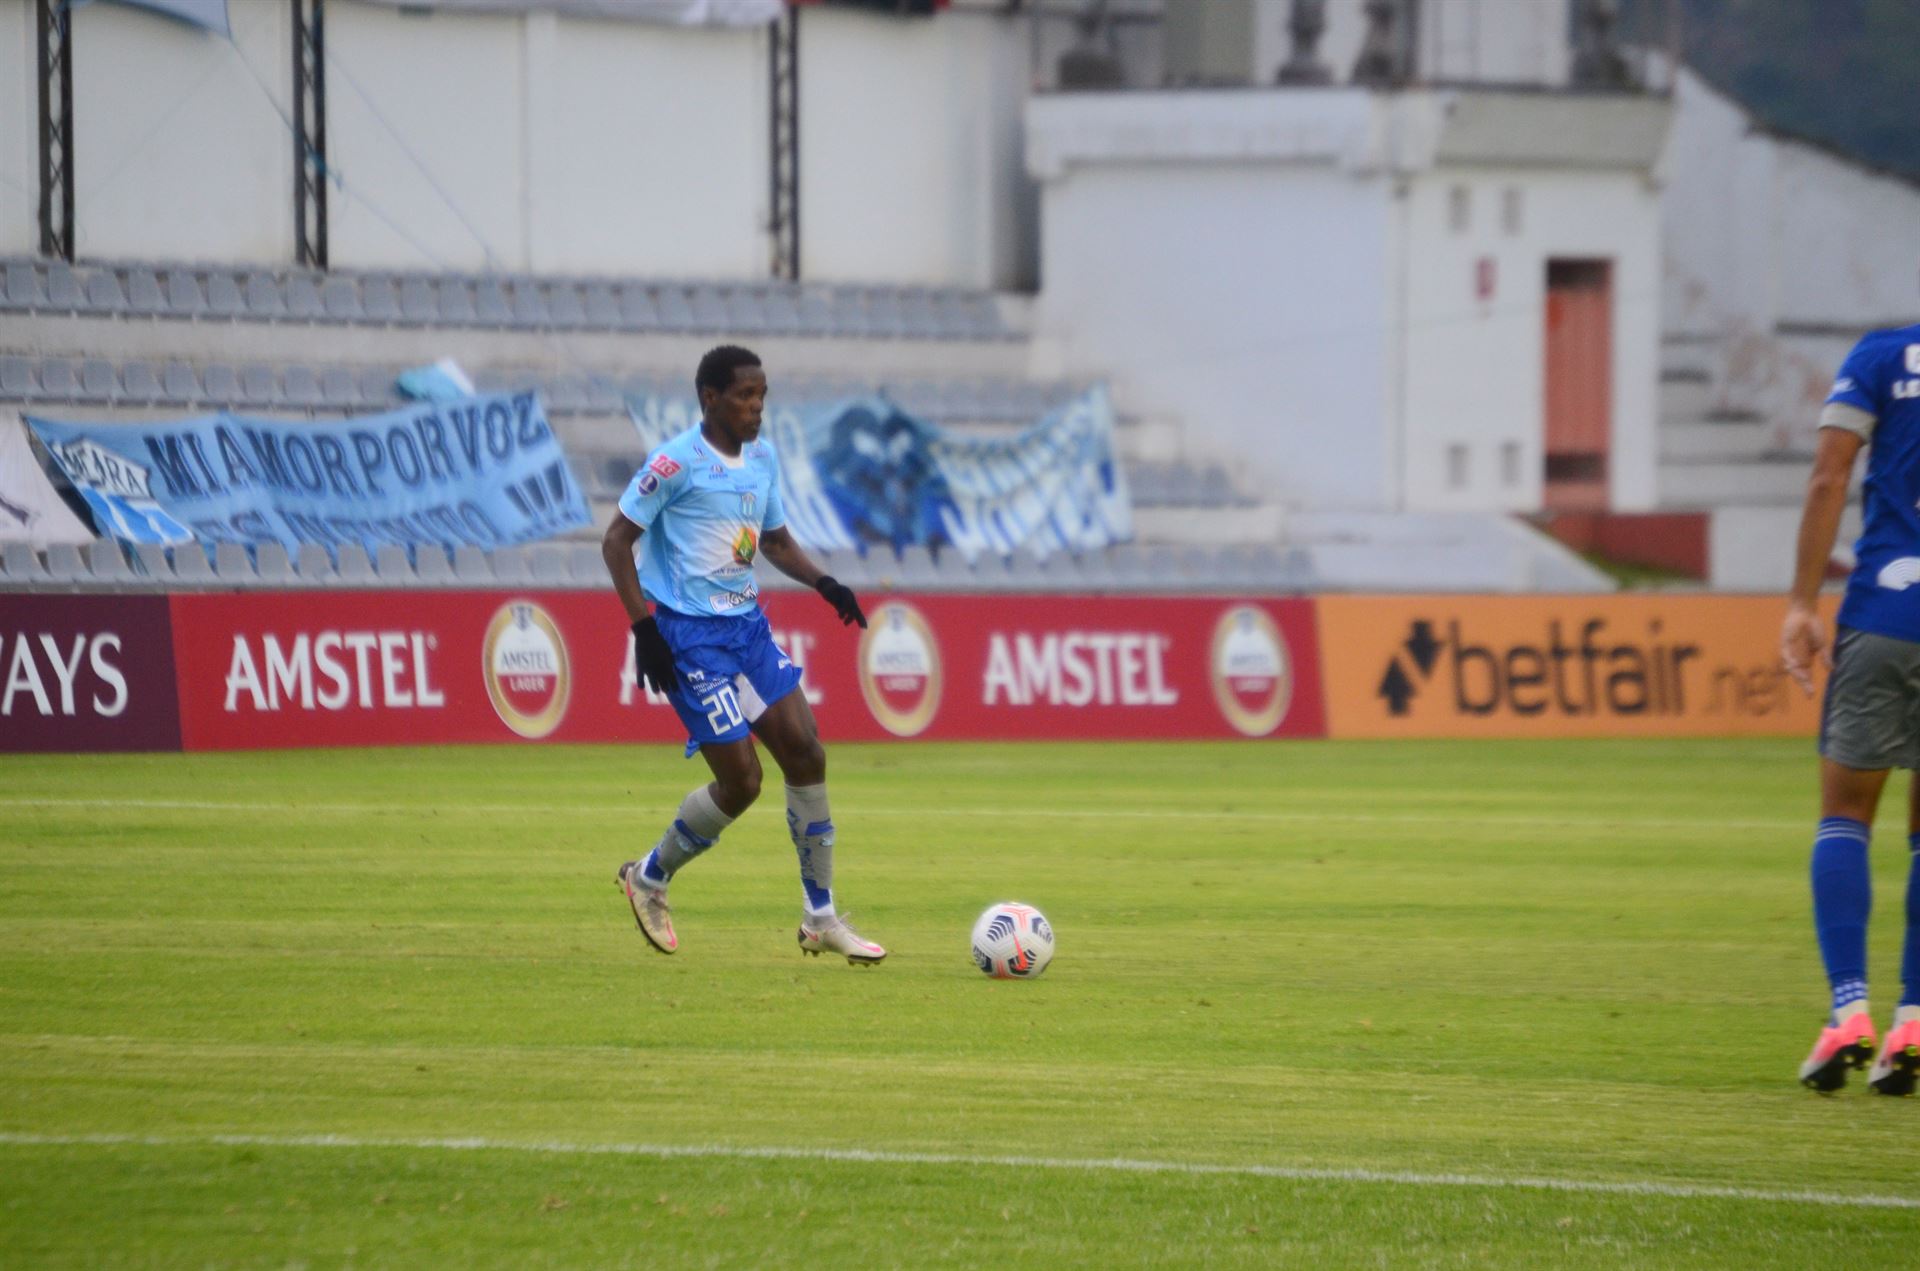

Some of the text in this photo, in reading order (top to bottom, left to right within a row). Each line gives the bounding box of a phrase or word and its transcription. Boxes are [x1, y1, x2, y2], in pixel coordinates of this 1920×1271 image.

[214, 423, 367, 500] AMOR
[348, 412, 460, 497] POR
[447, 390, 551, 473] VOZ
[0, 631, 129, 717] AYS
[223, 630, 445, 712] AMSTEL
[982, 629, 1180, 706] AMSTEL
[1448, 618, 1702, 716] betfair
[701, 683, 743, 736] 20
